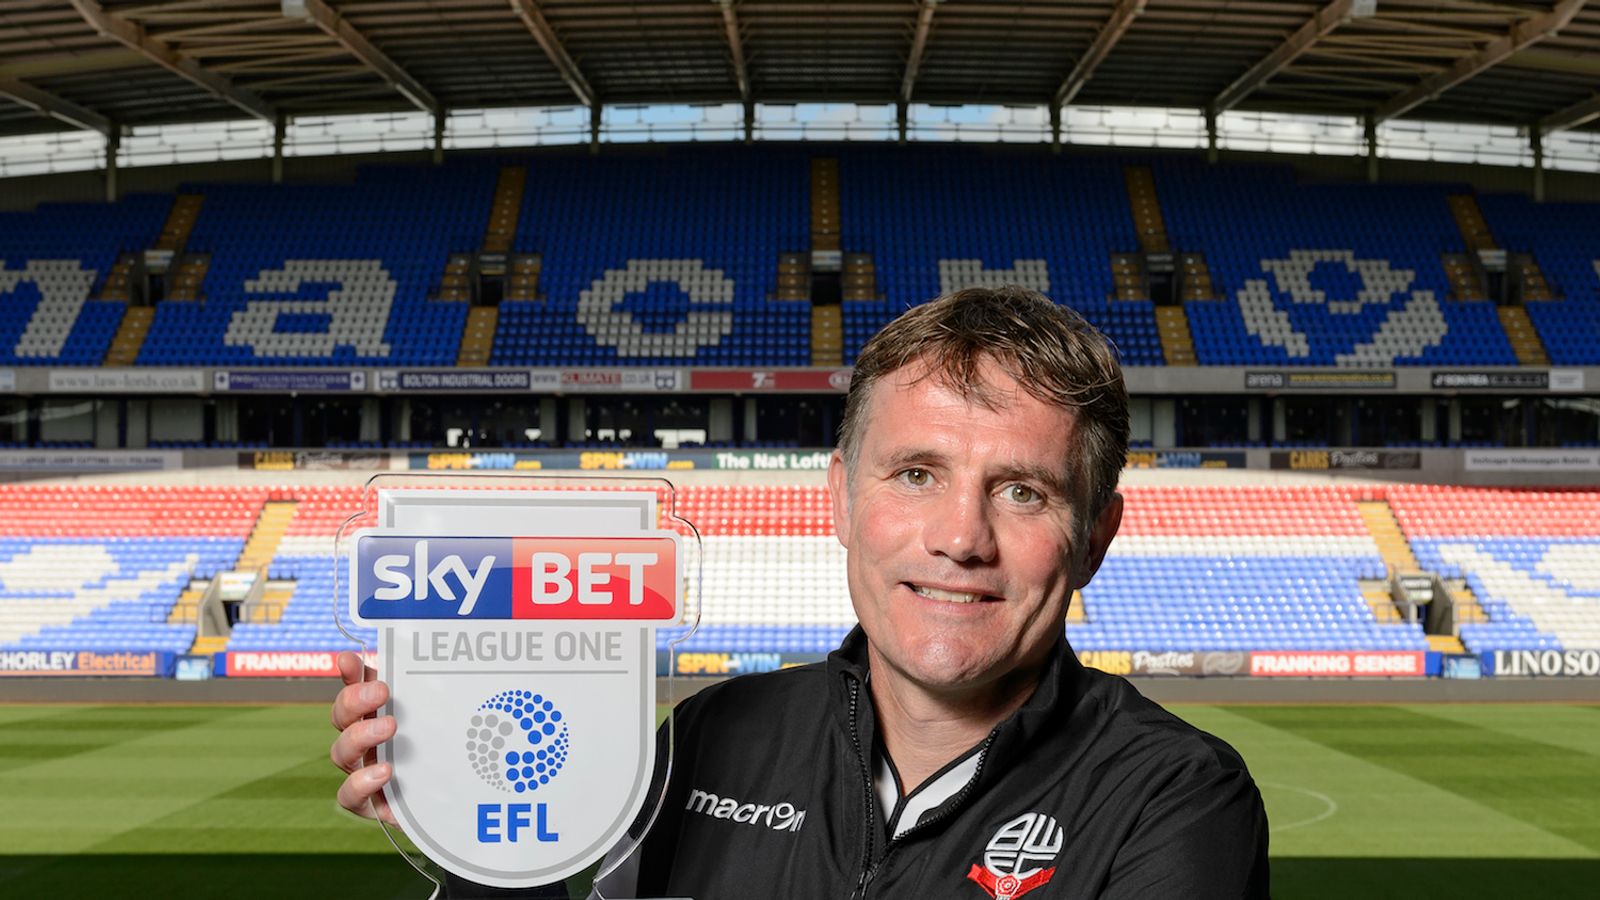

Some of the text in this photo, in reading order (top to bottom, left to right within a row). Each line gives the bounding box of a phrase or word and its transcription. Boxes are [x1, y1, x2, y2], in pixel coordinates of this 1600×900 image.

[403, 374, 528, 387] BOLTON INDUSTRIAL DOORS
[1248, 374, 1283, 386] arena
[717, 453, 750, 469] The
[754, 453, 788, 469] Nat
[1290, 451, 1329, 470] CARRS
[373, 540, 658, 616] sky BET
[412, 632, 622, 661] LEAGUE ONE
[0, 652, 156, 670] HORLEY Electrical
[234, 653, 333, 671] FRANKING
[1080, 651, 1195, 675] CARRS Pasties
[1252, 654, 1417, 672] FRANKING SENSE
[477, 803, 559, 842] EFL
